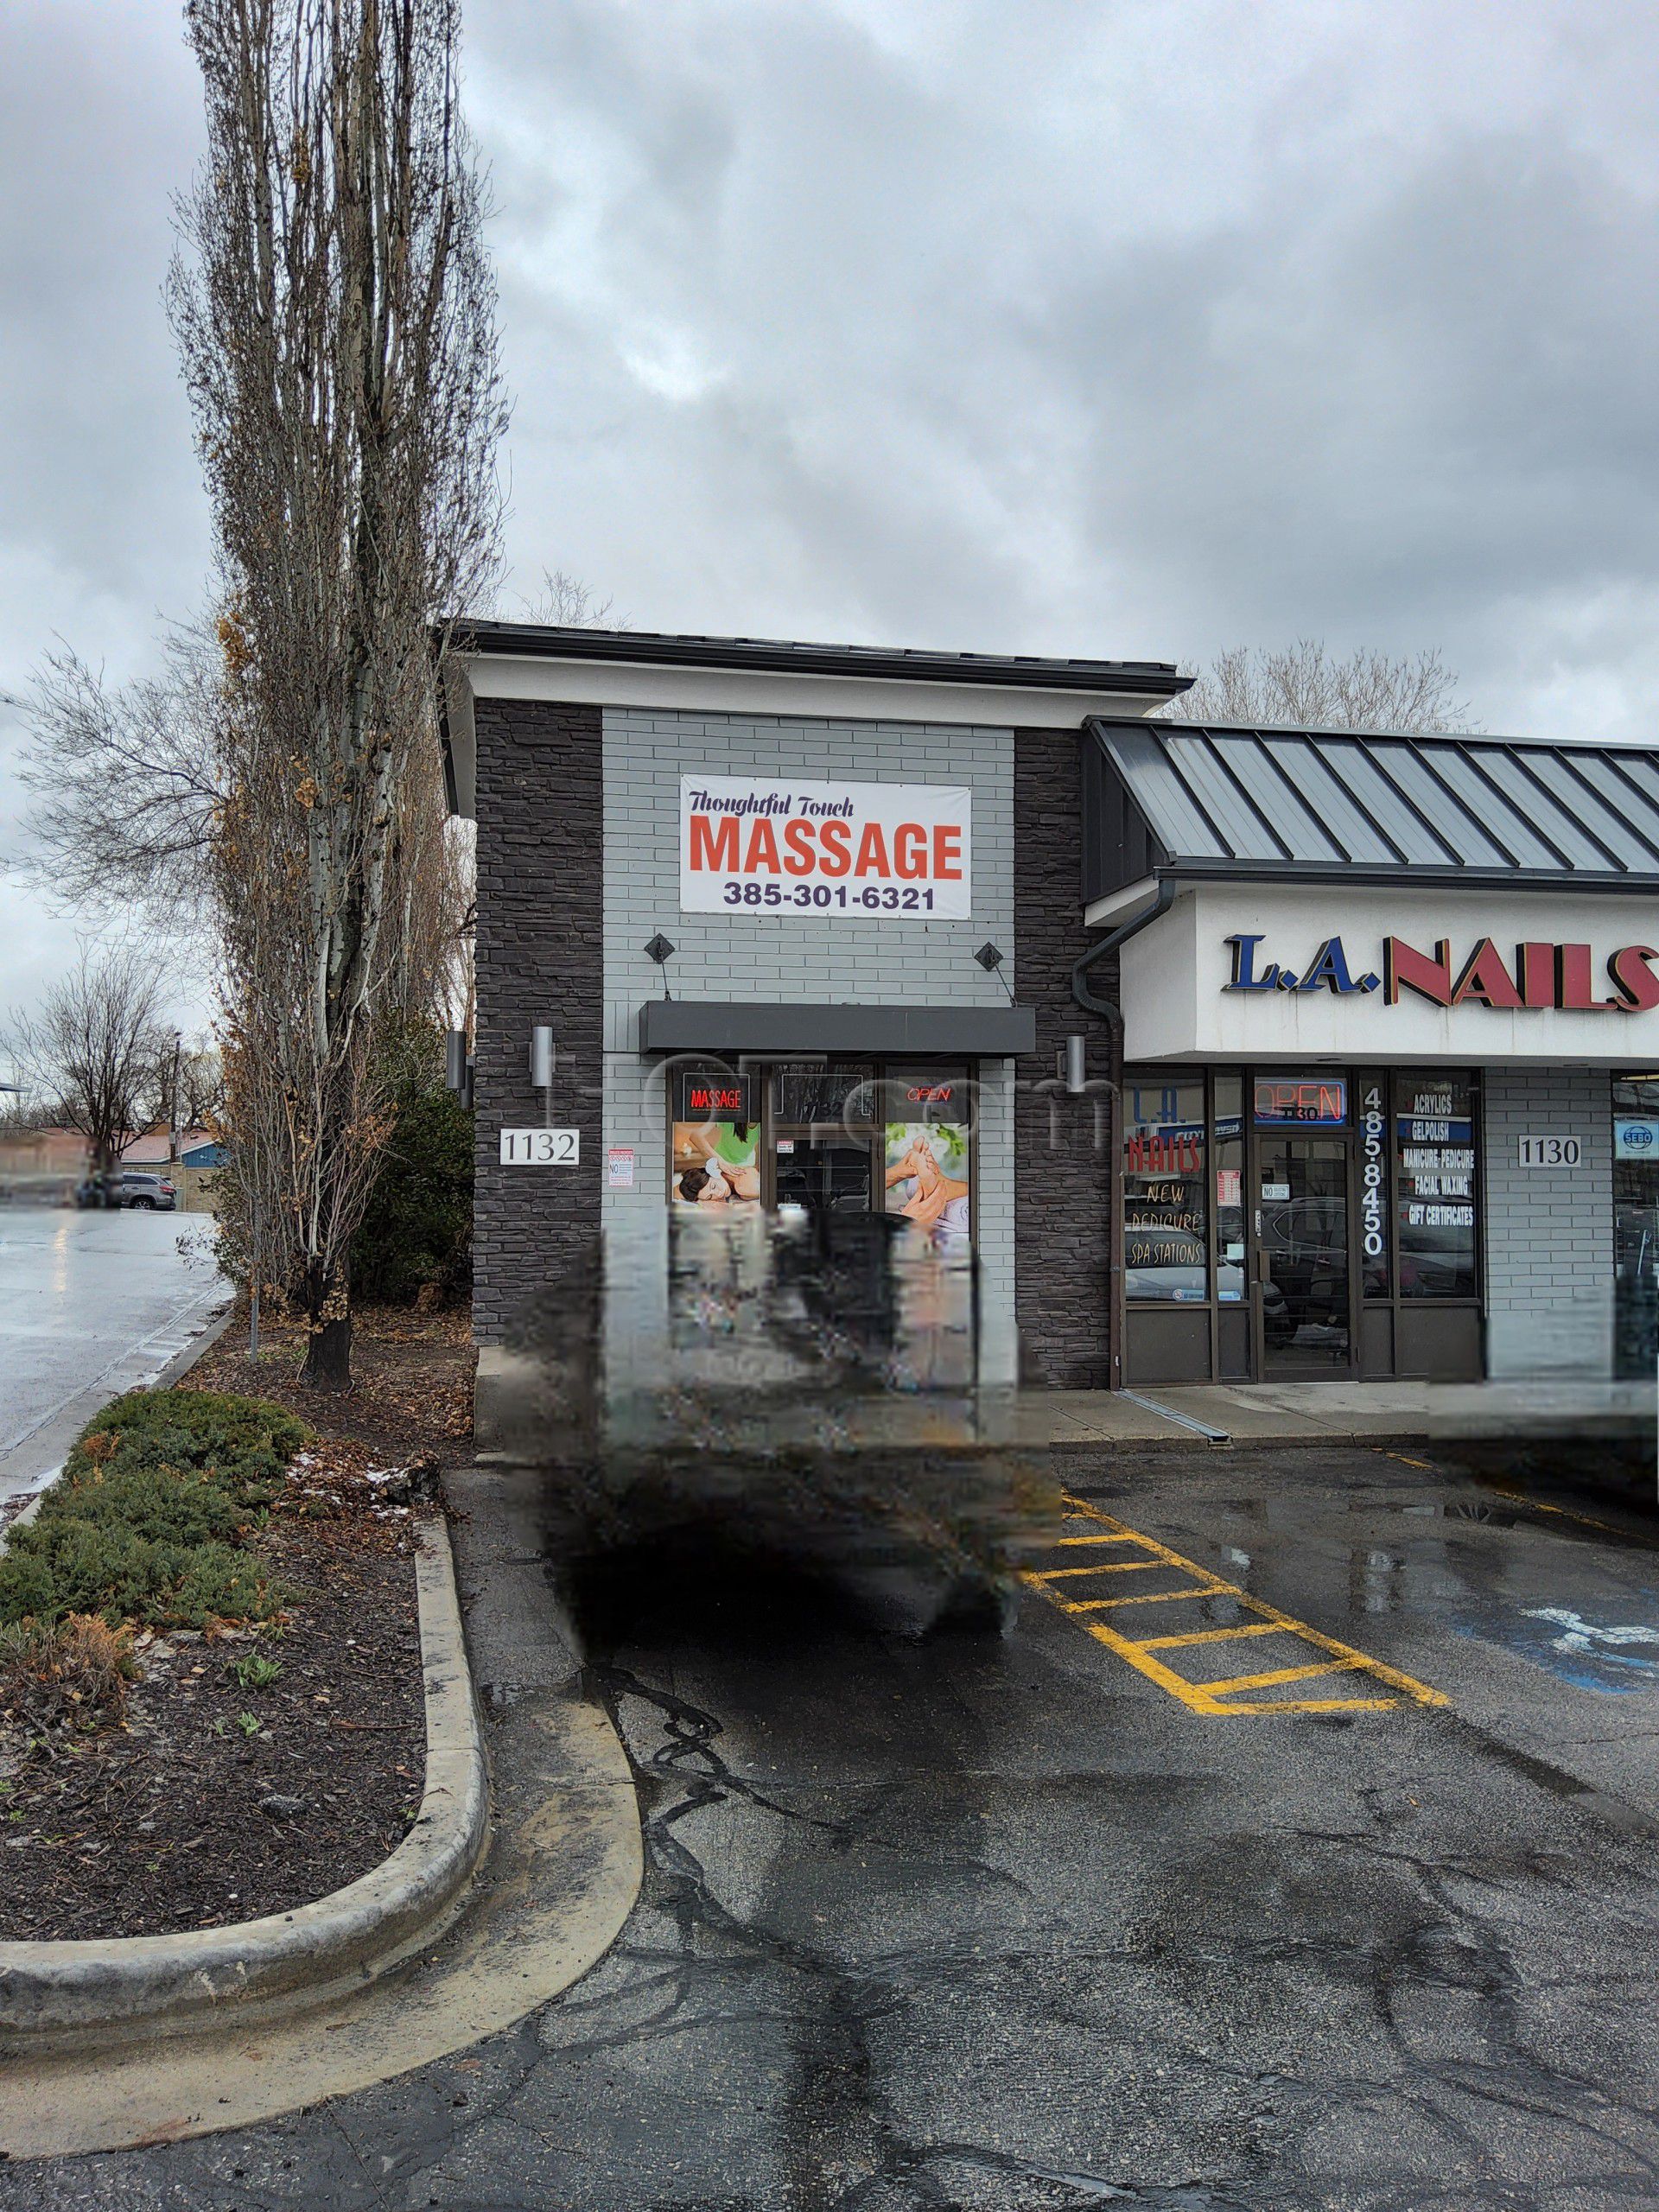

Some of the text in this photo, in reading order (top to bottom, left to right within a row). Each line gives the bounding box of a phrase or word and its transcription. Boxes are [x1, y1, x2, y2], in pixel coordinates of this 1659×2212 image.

[689, 790, 854, 818] Thoughtful Touch
[690, 815, 963, 880] MASSAGE
[723, 882, 934, 911] 385-301-6321
[1221, 933, 1659, 1012] L.A. NAILS
[691, 1089, 741, 1109] MASSAGE
[907, 1085, 952, 1103] OPEN
[1255, 1084, 1341, 1120] OPEN
[1414, 1094, 1452, 1115] ACRYLICS
[505, 1133, 576, 1162] 1132
[1624, 1133, 1651, 1142] SEBO
[1128, 1132, 1201, 1173] NAILS
[1521, 1138, 1580, 1165] 1130
[1147, 1183, 1185, 1204] NEW
[1263, 1186, 1273, 1197] NO
[1414, 1175, 1468, 1196] FACIAL WAXING
[1132, 1211, 1201, 1232] PEDICURE
[1408, 1204, 1474, 1227] GIFT CERTIFICATES
[1131, 1242, 1201, 1264] SPA STATIONS
